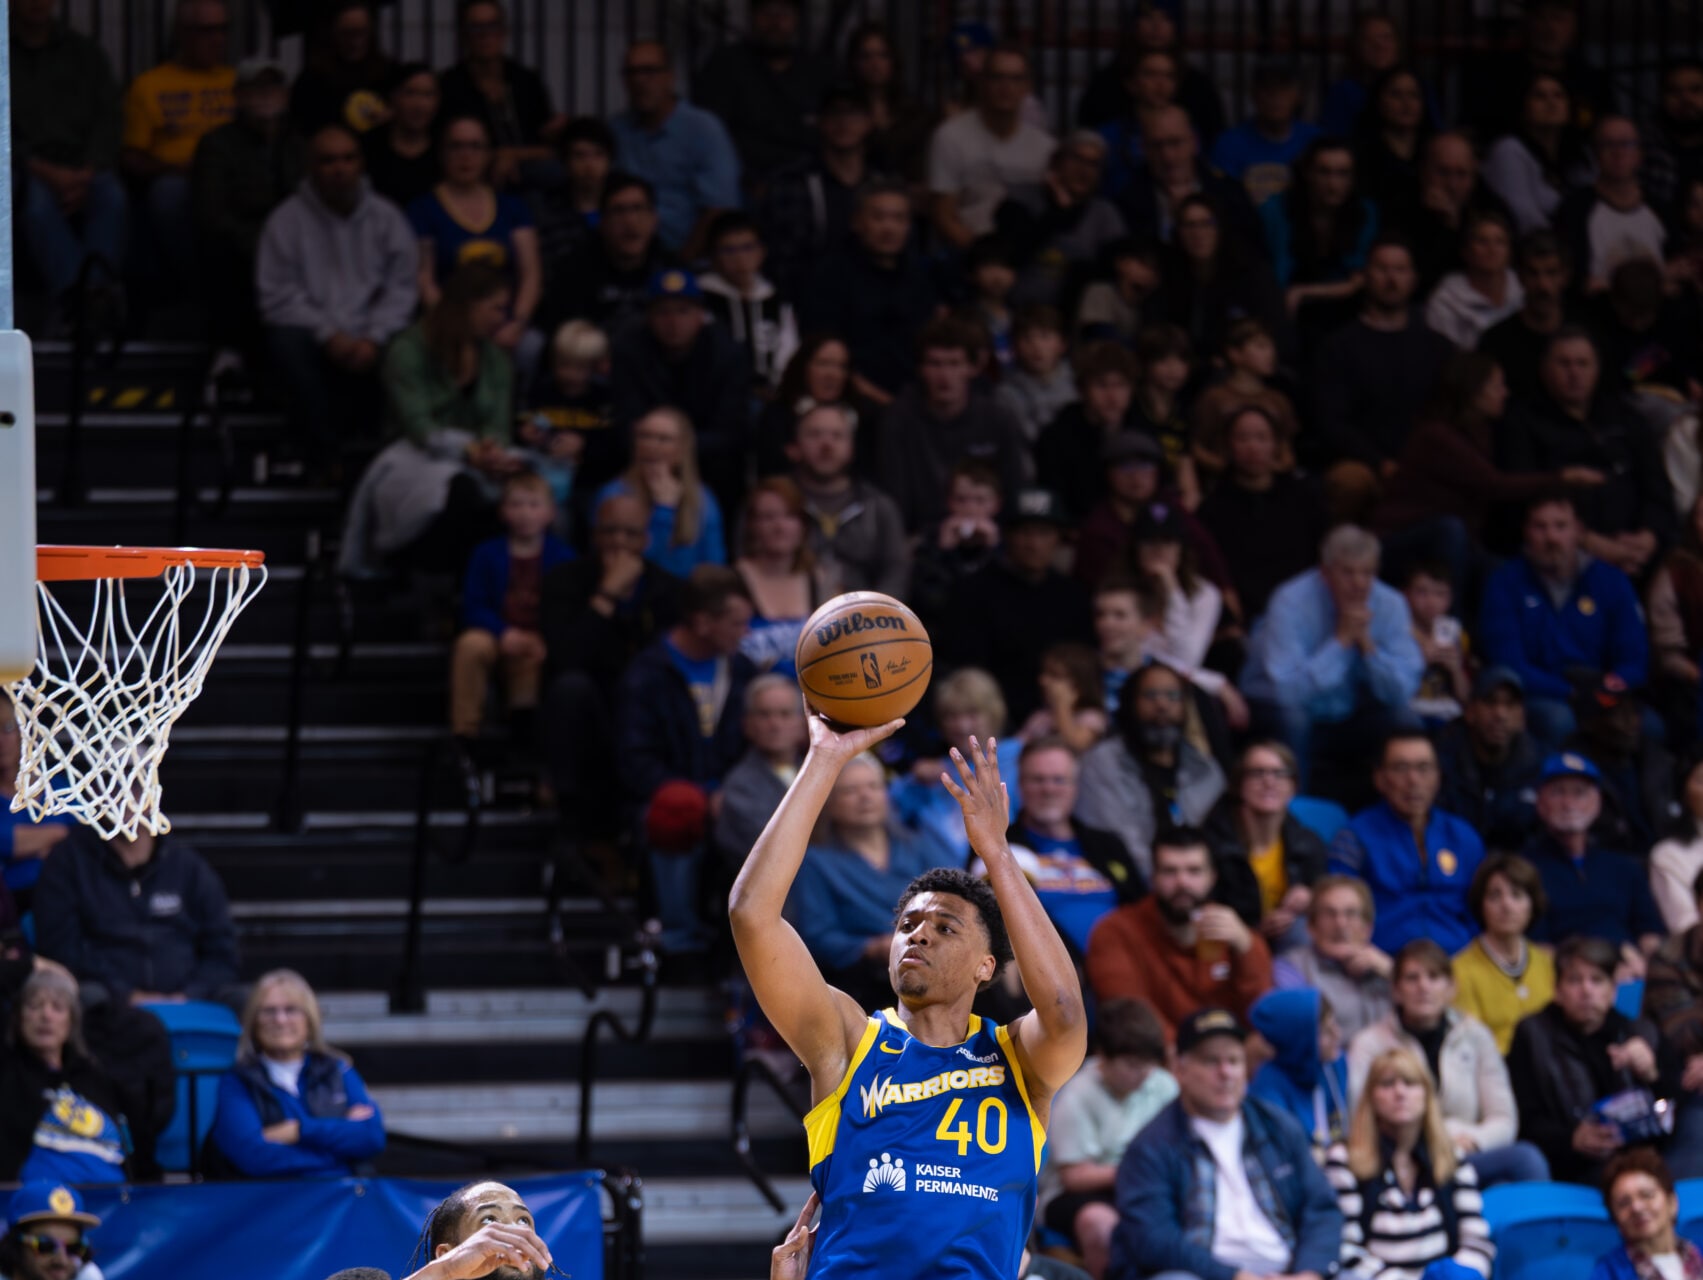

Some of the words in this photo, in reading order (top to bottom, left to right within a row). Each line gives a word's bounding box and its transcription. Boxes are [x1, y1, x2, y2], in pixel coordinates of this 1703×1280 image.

[815, 612, 907, 647] Wilson
[860, 1065, 1006, 1119] WARRIORS
[935, 1096, 1008, 1156] 40
[916, 1163, 961, 1179] KAISER
[915, 1179, 999, 1202] PERMANENTE
